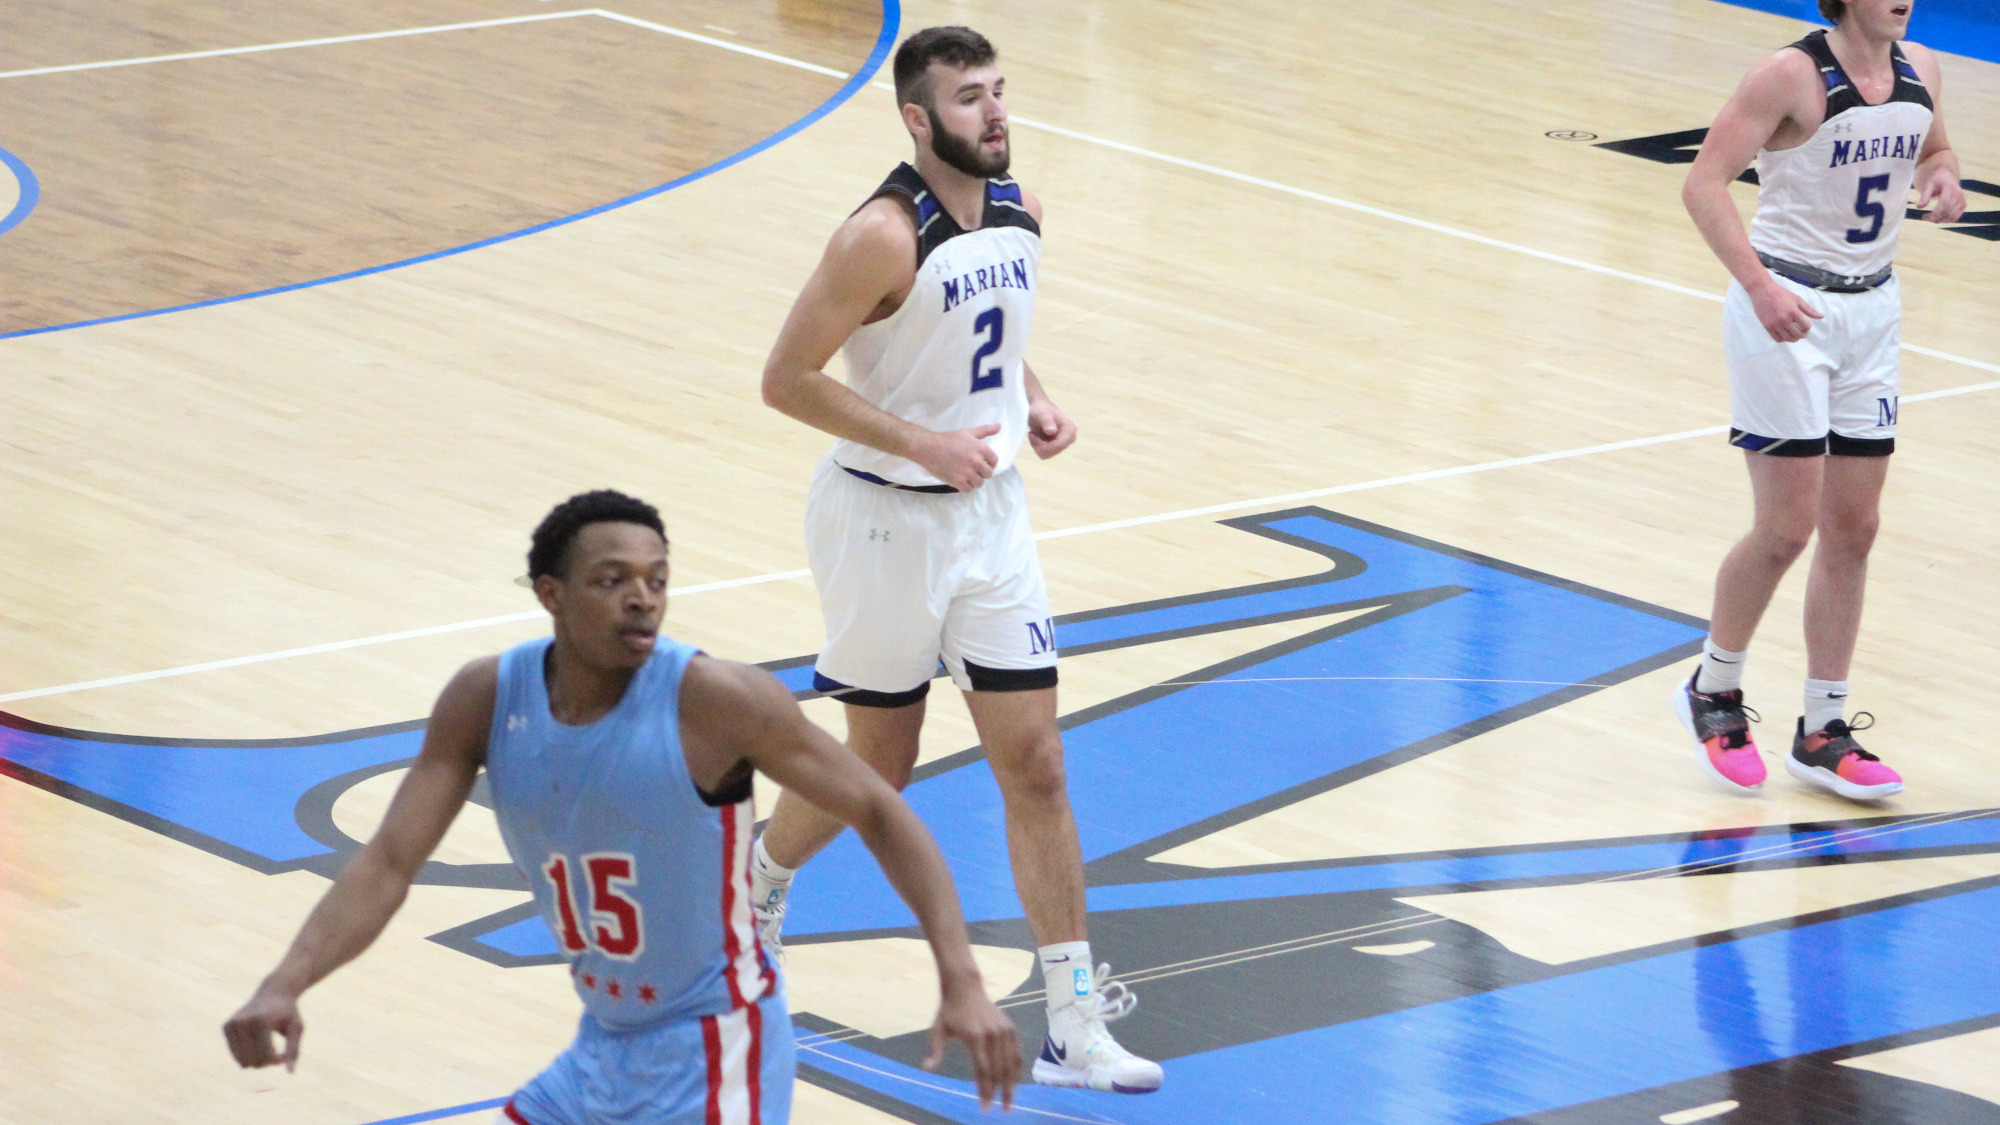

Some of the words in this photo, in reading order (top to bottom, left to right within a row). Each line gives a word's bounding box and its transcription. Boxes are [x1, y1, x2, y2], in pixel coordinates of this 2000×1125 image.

[1829, 133, 1921, 168] MARIAN
[1846, 172, 1890, 244] 5
[942, 258, 1029, 313] MARIAN
[969, 305, 1004, 394] 2
[1876, 396, 1898, 427] M
[1025, 618, 1055, 655] M
[542, 853, 645, 962] 15
